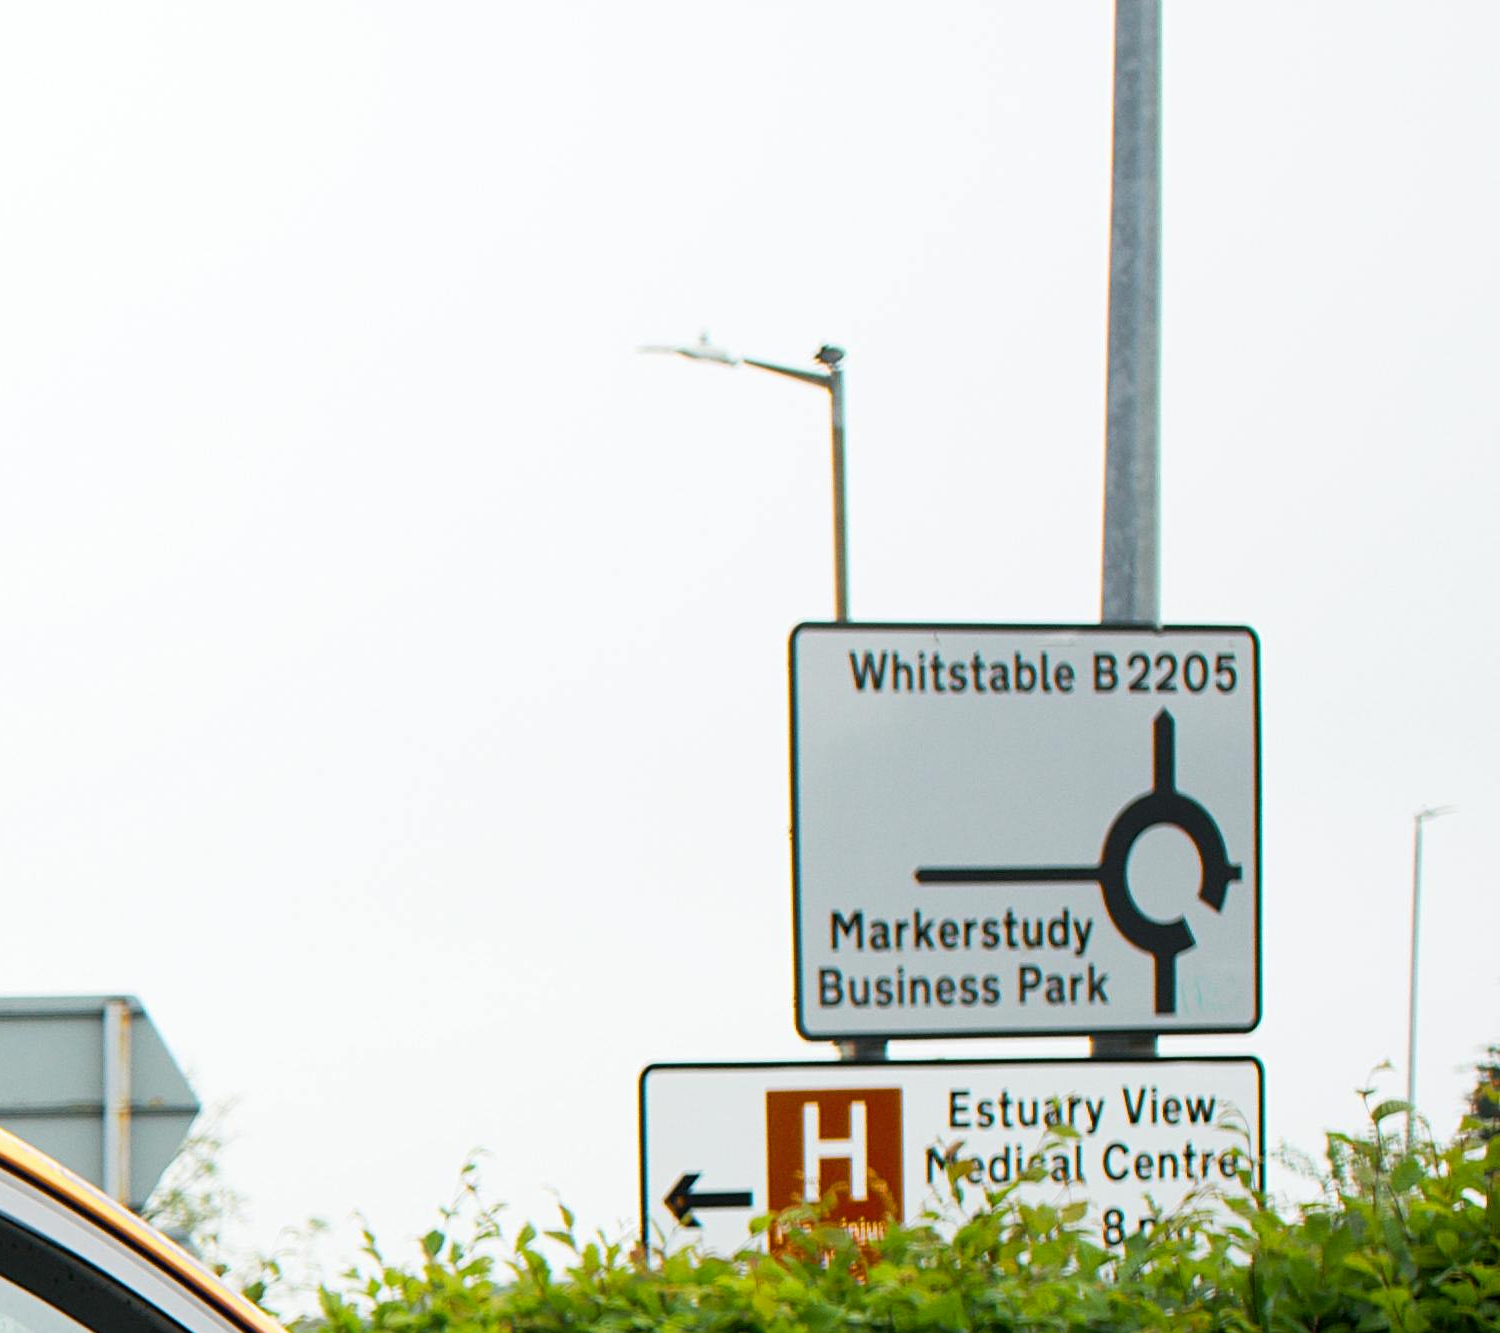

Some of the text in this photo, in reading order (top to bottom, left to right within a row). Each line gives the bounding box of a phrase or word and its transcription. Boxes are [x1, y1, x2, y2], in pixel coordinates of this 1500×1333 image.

[849, 651, 1076, 695] Whitstable
[830, 908, 1095, 959] Markerstudy
[818, 964, 1111, 1009] Business Park
[949, 1087, 1217, 1134] Estuary View
[1102, 1142, 1239, 1182] Centre
